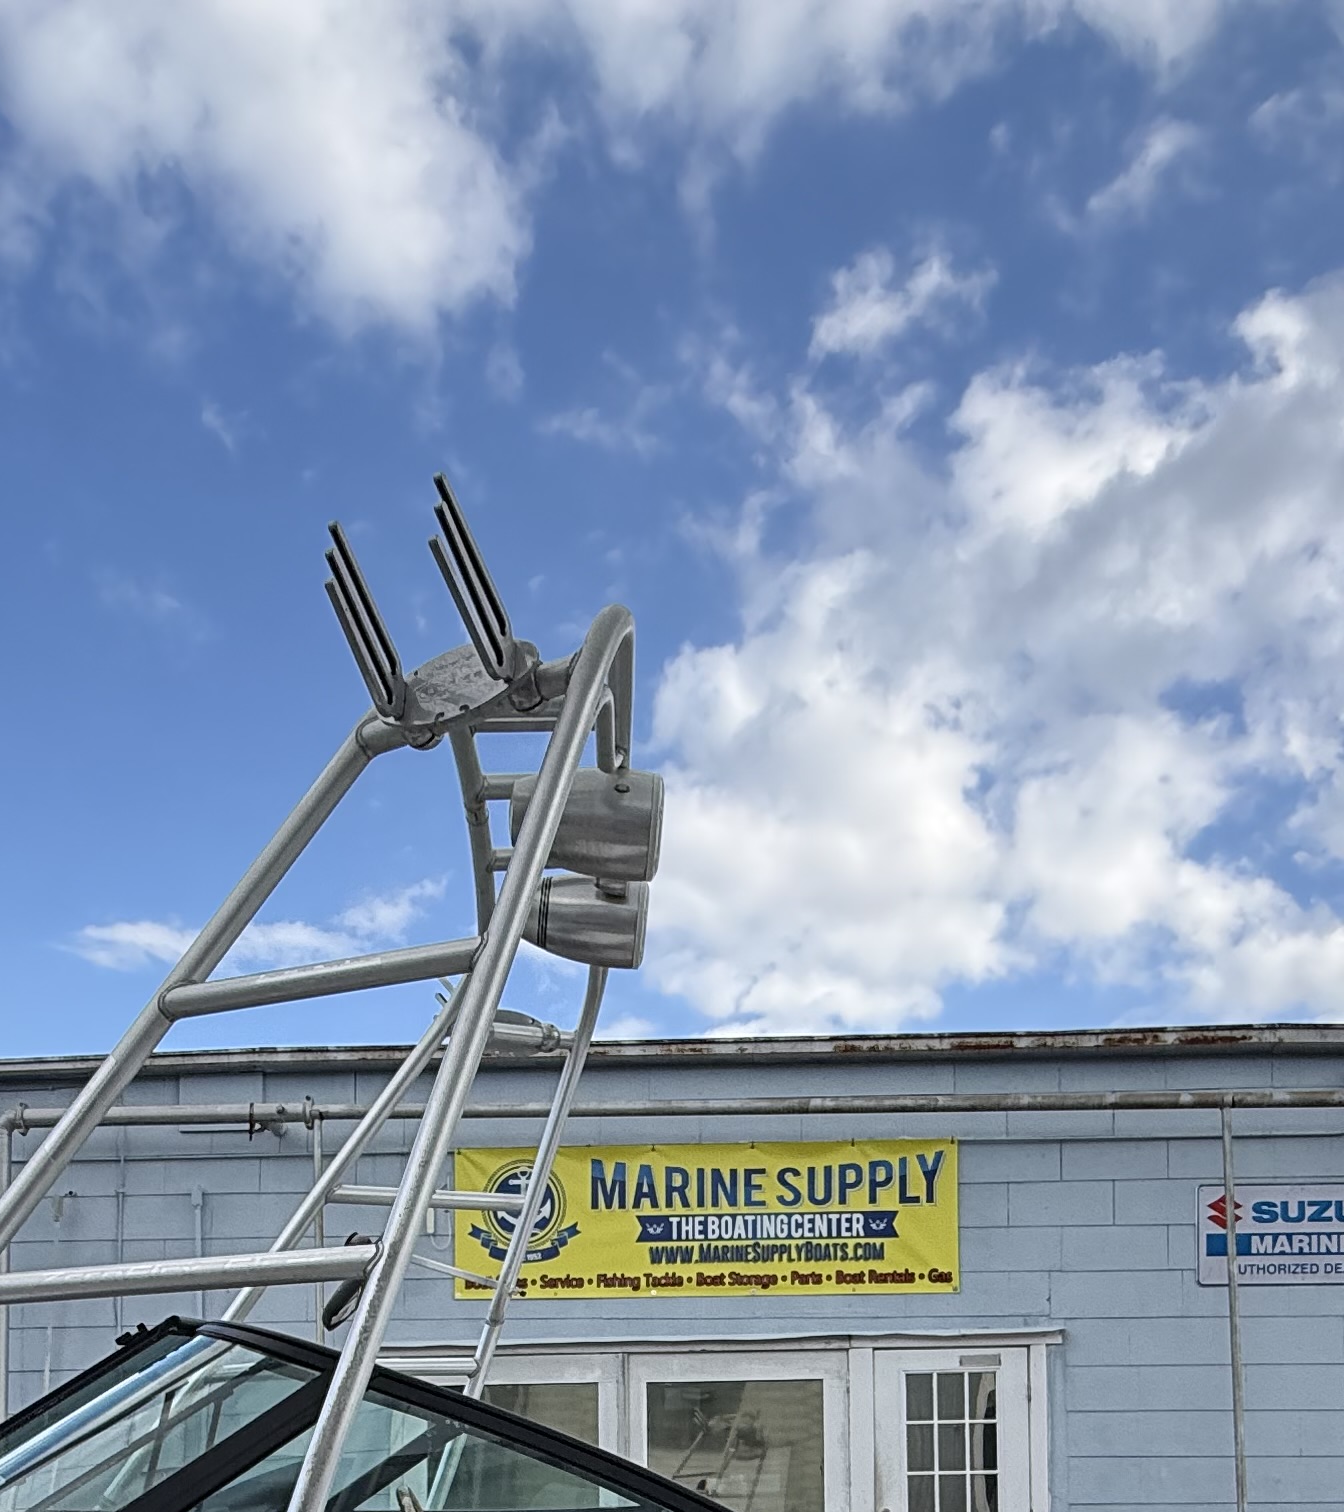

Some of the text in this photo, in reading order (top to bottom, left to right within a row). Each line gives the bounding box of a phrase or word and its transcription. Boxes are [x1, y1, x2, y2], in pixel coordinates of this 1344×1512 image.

[590, 1150, 945, 1211] MARINE SUPPLY
[539, 1273, 584, 1289] Service
[596, 1273, 641, 1291] Fishing
[643, 1272, 683, 1288] Tackle
[696, 1272, 726, 1287] Boat
[728, 1271, 778, 1289] Storage
[790, 1271, 823, 1286] Parts
[835, 1269, 866, 1284] Boat
[868, 1268, 915, 1284] Rentals
[928, 1268, 953, 1283] Gas
[1238, 1262, 1320, 1275] UTHORIZED
